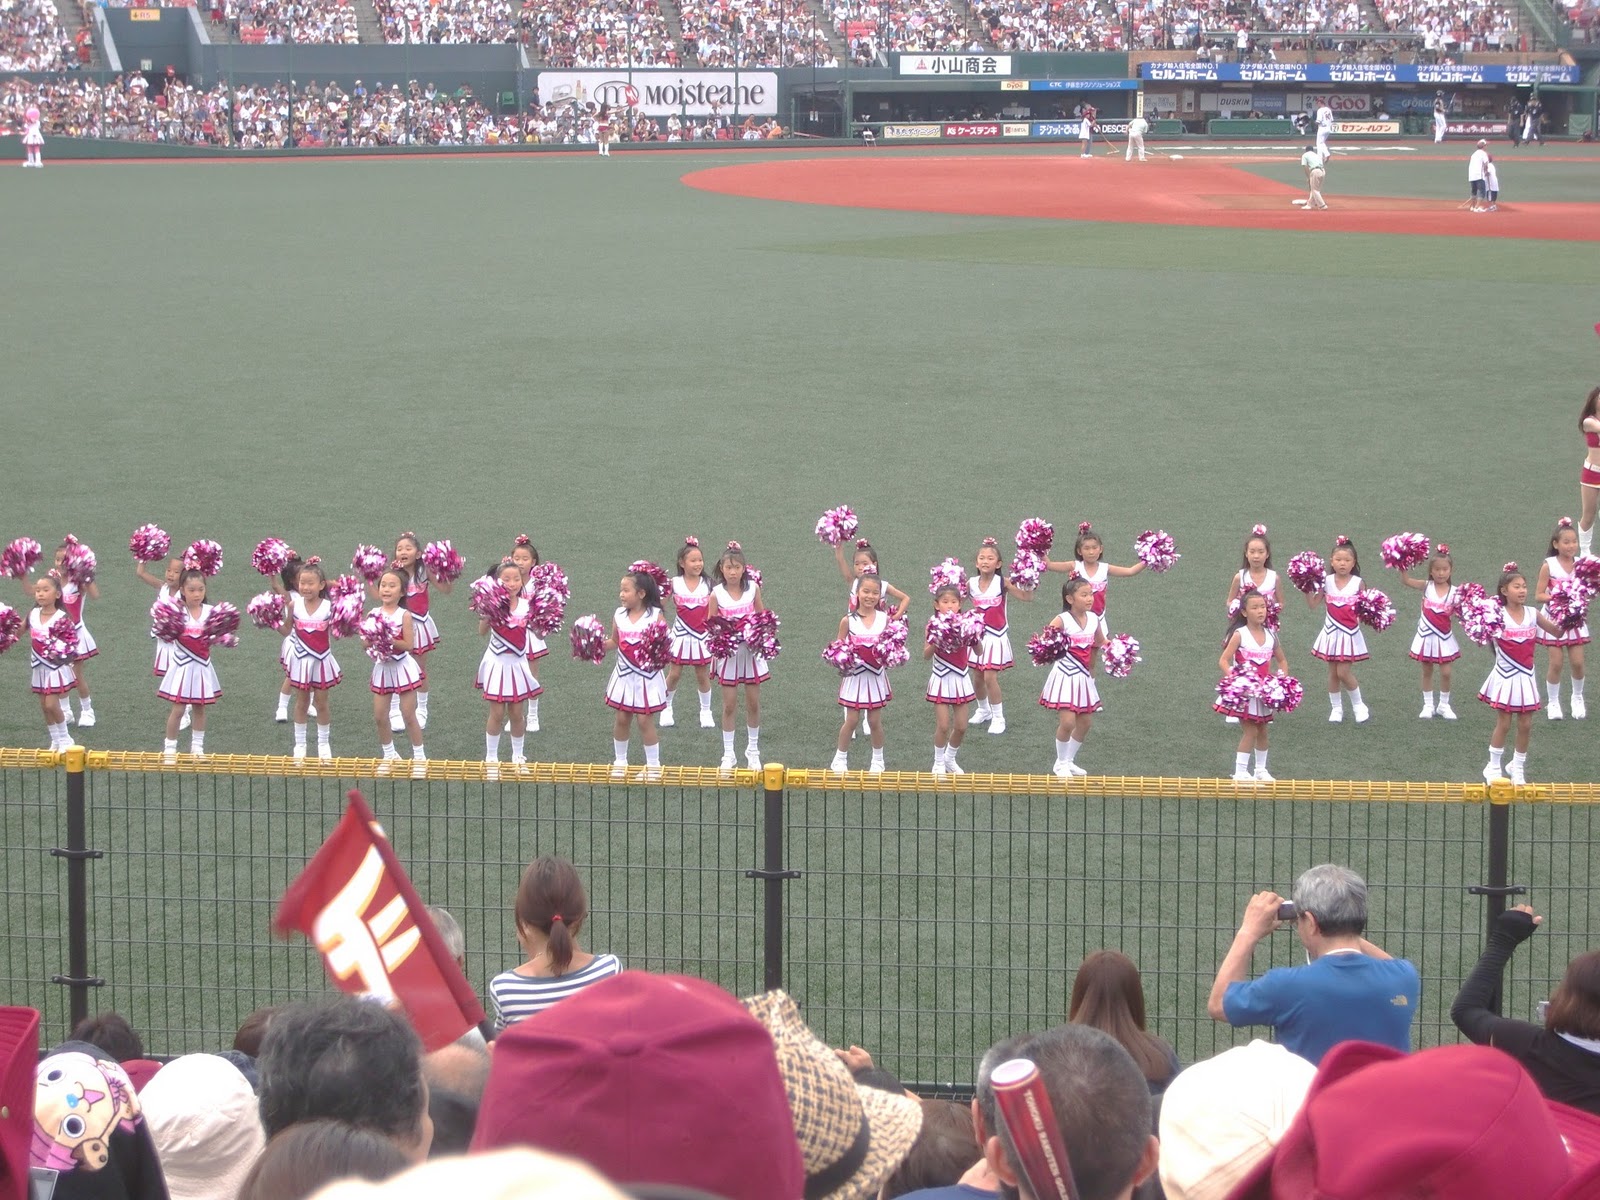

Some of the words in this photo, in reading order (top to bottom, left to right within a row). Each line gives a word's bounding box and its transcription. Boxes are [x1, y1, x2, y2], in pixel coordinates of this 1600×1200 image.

[931, 57, 997, 74] 小山商会
[1150, 69, 1218, 80] セルコホーム
[1239, 70, 1307, 81] セルコホーム
[1329, 71, 1396, 82] セルコホーム
[1417, 71, 1483, 82] セルコホーム
[645, 79, 764, 106] Moisteane
[1220, 98, 1250, 106] DUSKIN
[959, 126, 998, 135] ケーズデンキ
[1039, 124, 1080, 135] チケットぴあ
[1102, 124, 1127, 133] DESCE
[1505, 630, 1533, 638] ANGELS
[1024, 1089, 1044, 1131] TOHOKU
[1038, 1131, 1060, 1178] RAKUTEN
